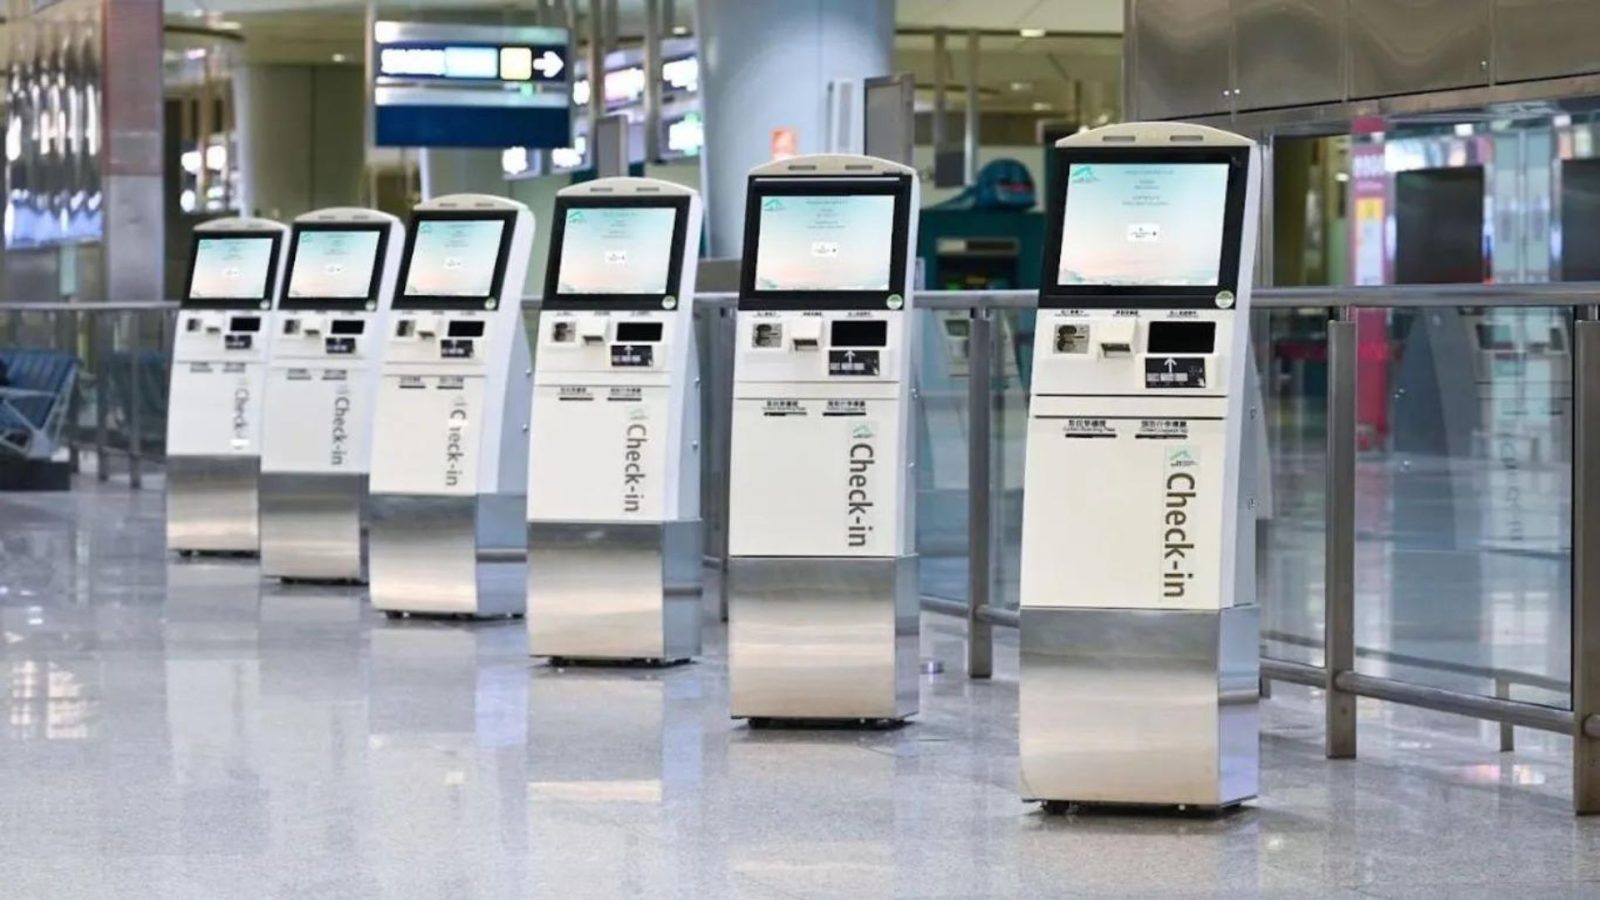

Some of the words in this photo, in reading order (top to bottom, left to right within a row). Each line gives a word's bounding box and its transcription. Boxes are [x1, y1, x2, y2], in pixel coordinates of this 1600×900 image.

[331, 396, 350, 466] Check-in
[624, 424, 648, 512] Check-in
[848, 443, 875, 547] Check-in
[1164, 472, 1197, 597] Check-in
